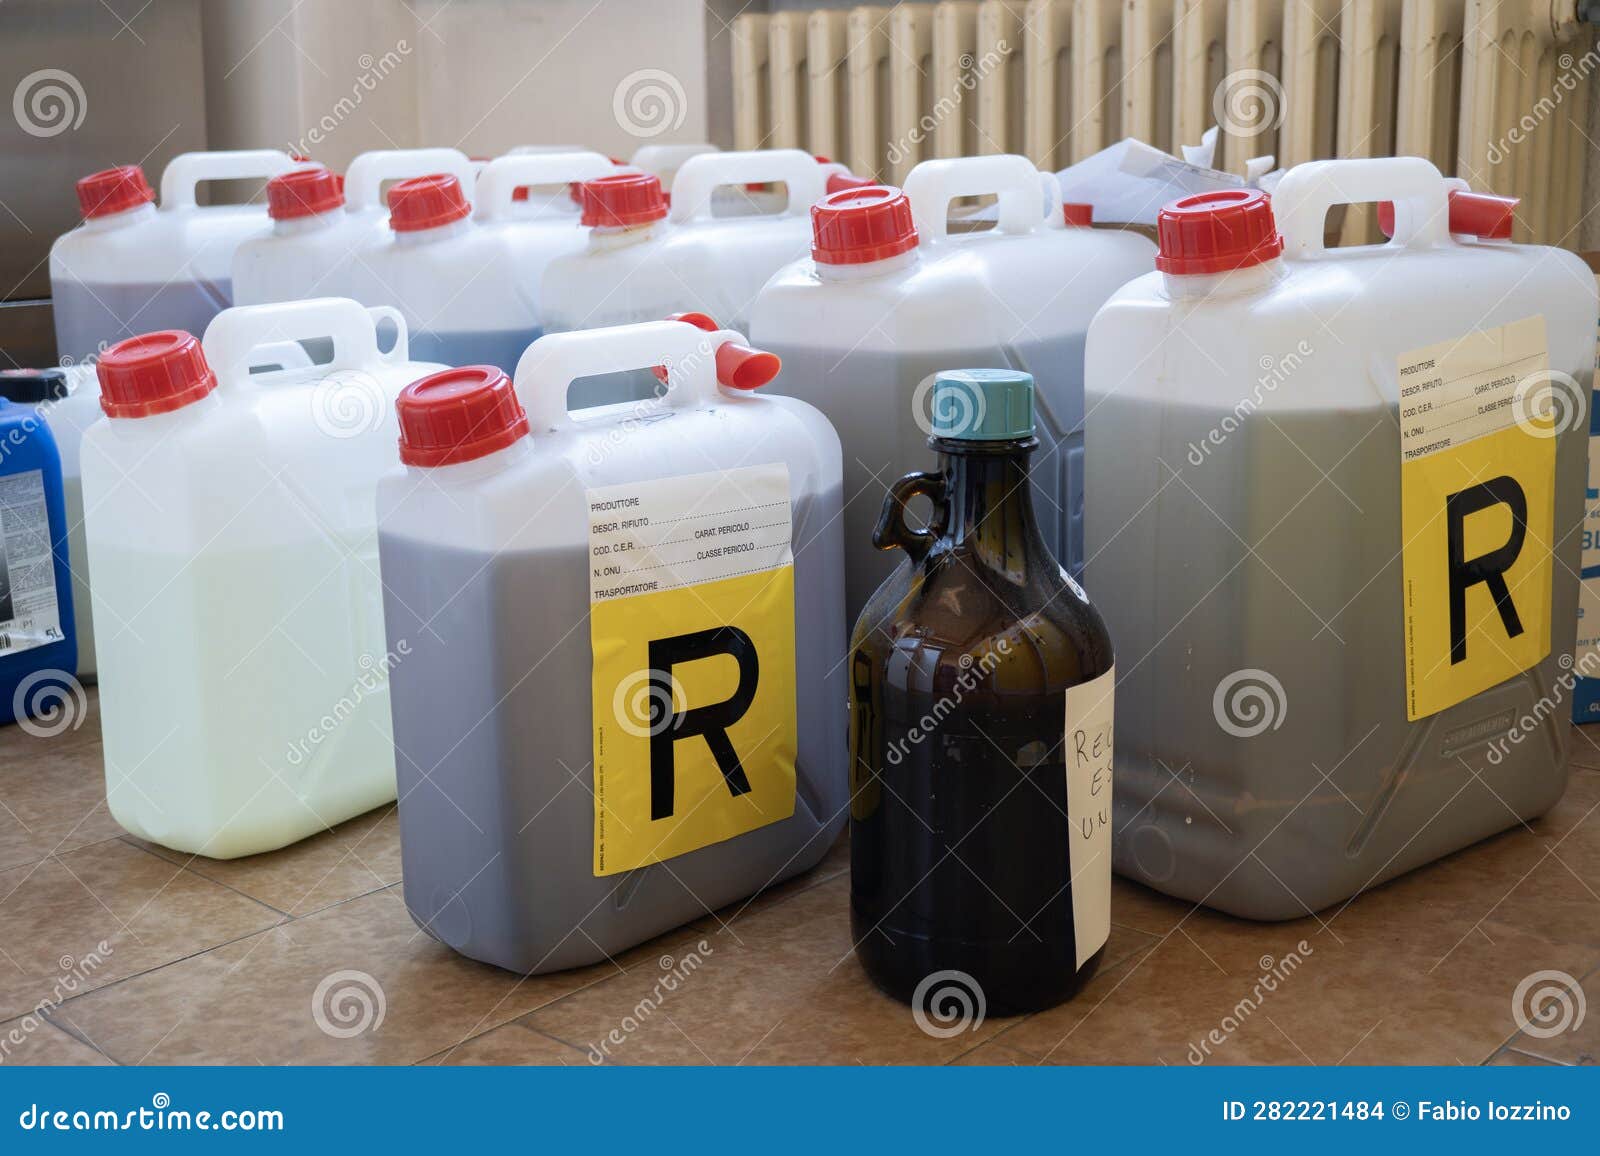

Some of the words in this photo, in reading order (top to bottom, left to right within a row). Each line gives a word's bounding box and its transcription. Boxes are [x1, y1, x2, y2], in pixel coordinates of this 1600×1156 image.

[1400, 359, 1435, 376] PRODUTTORE
[1402, 385, 1421, 397] DESCR.
[1422, 378, 1443, 391] RIFIUTO
[1403, 407, 1417, 418] COD.
[1418, 403, 1432, 415] C.E.R.
[1474, 383, 1491, 395] CARAT.
[1491, 375, 1516, 390] PERICOLO
[1404, 430, 1410, 439] N.
[1410, 426, 1424, 438] ONU
[1478, 402, 1497, 415] CLASSE
[1404, 438, 1451, 460] TRASPORTATORE
[591, 497, 640, 512] PRODUTTORE
[593, 522, 620, 534] DESCR.
[622, 518, 649, 530] RIFIUTO
[593, 546, 612, 556] COD.
[613, 542, 635, 553] C.E.R.
[694, 529, 716, 539] CARAT.
[718, 522, 750, 536] PERICOLO
[594, 568, 602, 577] N.
[604, 566, 621, 576] ONU
[697, 549, 722, 560] CLASSE
[723, 543, 755, 556] PERICOLO
[1446, 475, 1527, 666] R
[595, 582, 659, 599] TRASPORTATORE
[45, 626, 61, 640] 5L
[648, 625, 759, 821] R
